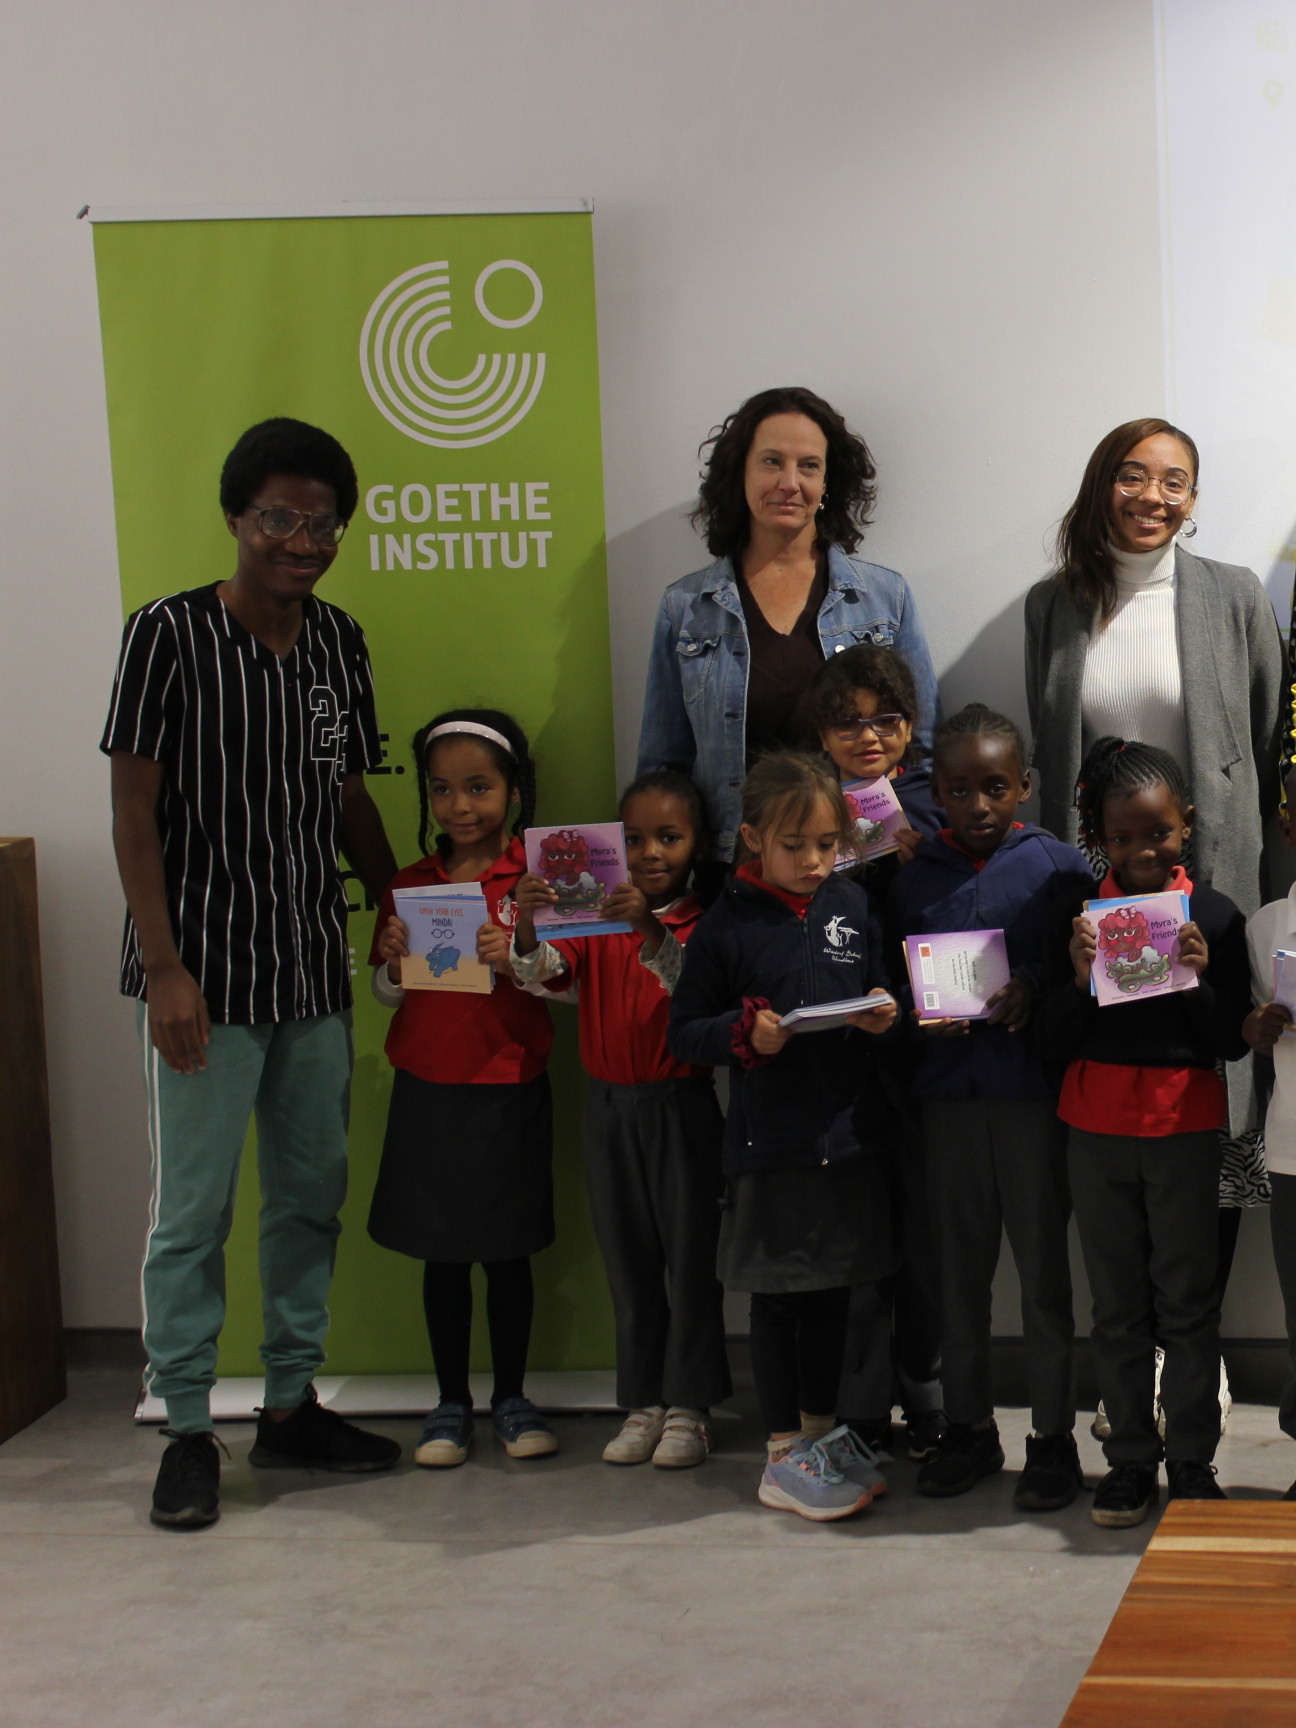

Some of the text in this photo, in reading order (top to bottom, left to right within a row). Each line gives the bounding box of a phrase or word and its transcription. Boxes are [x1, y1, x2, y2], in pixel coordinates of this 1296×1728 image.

[365, 482, 551, 524] GOETHE
[369, 531, 553, 571] INSTITUT
[860, 792, 886, 806] Myra's
[863, 799, 891, 813] Friends
[1150, 917, 1178, 930] Myra's
